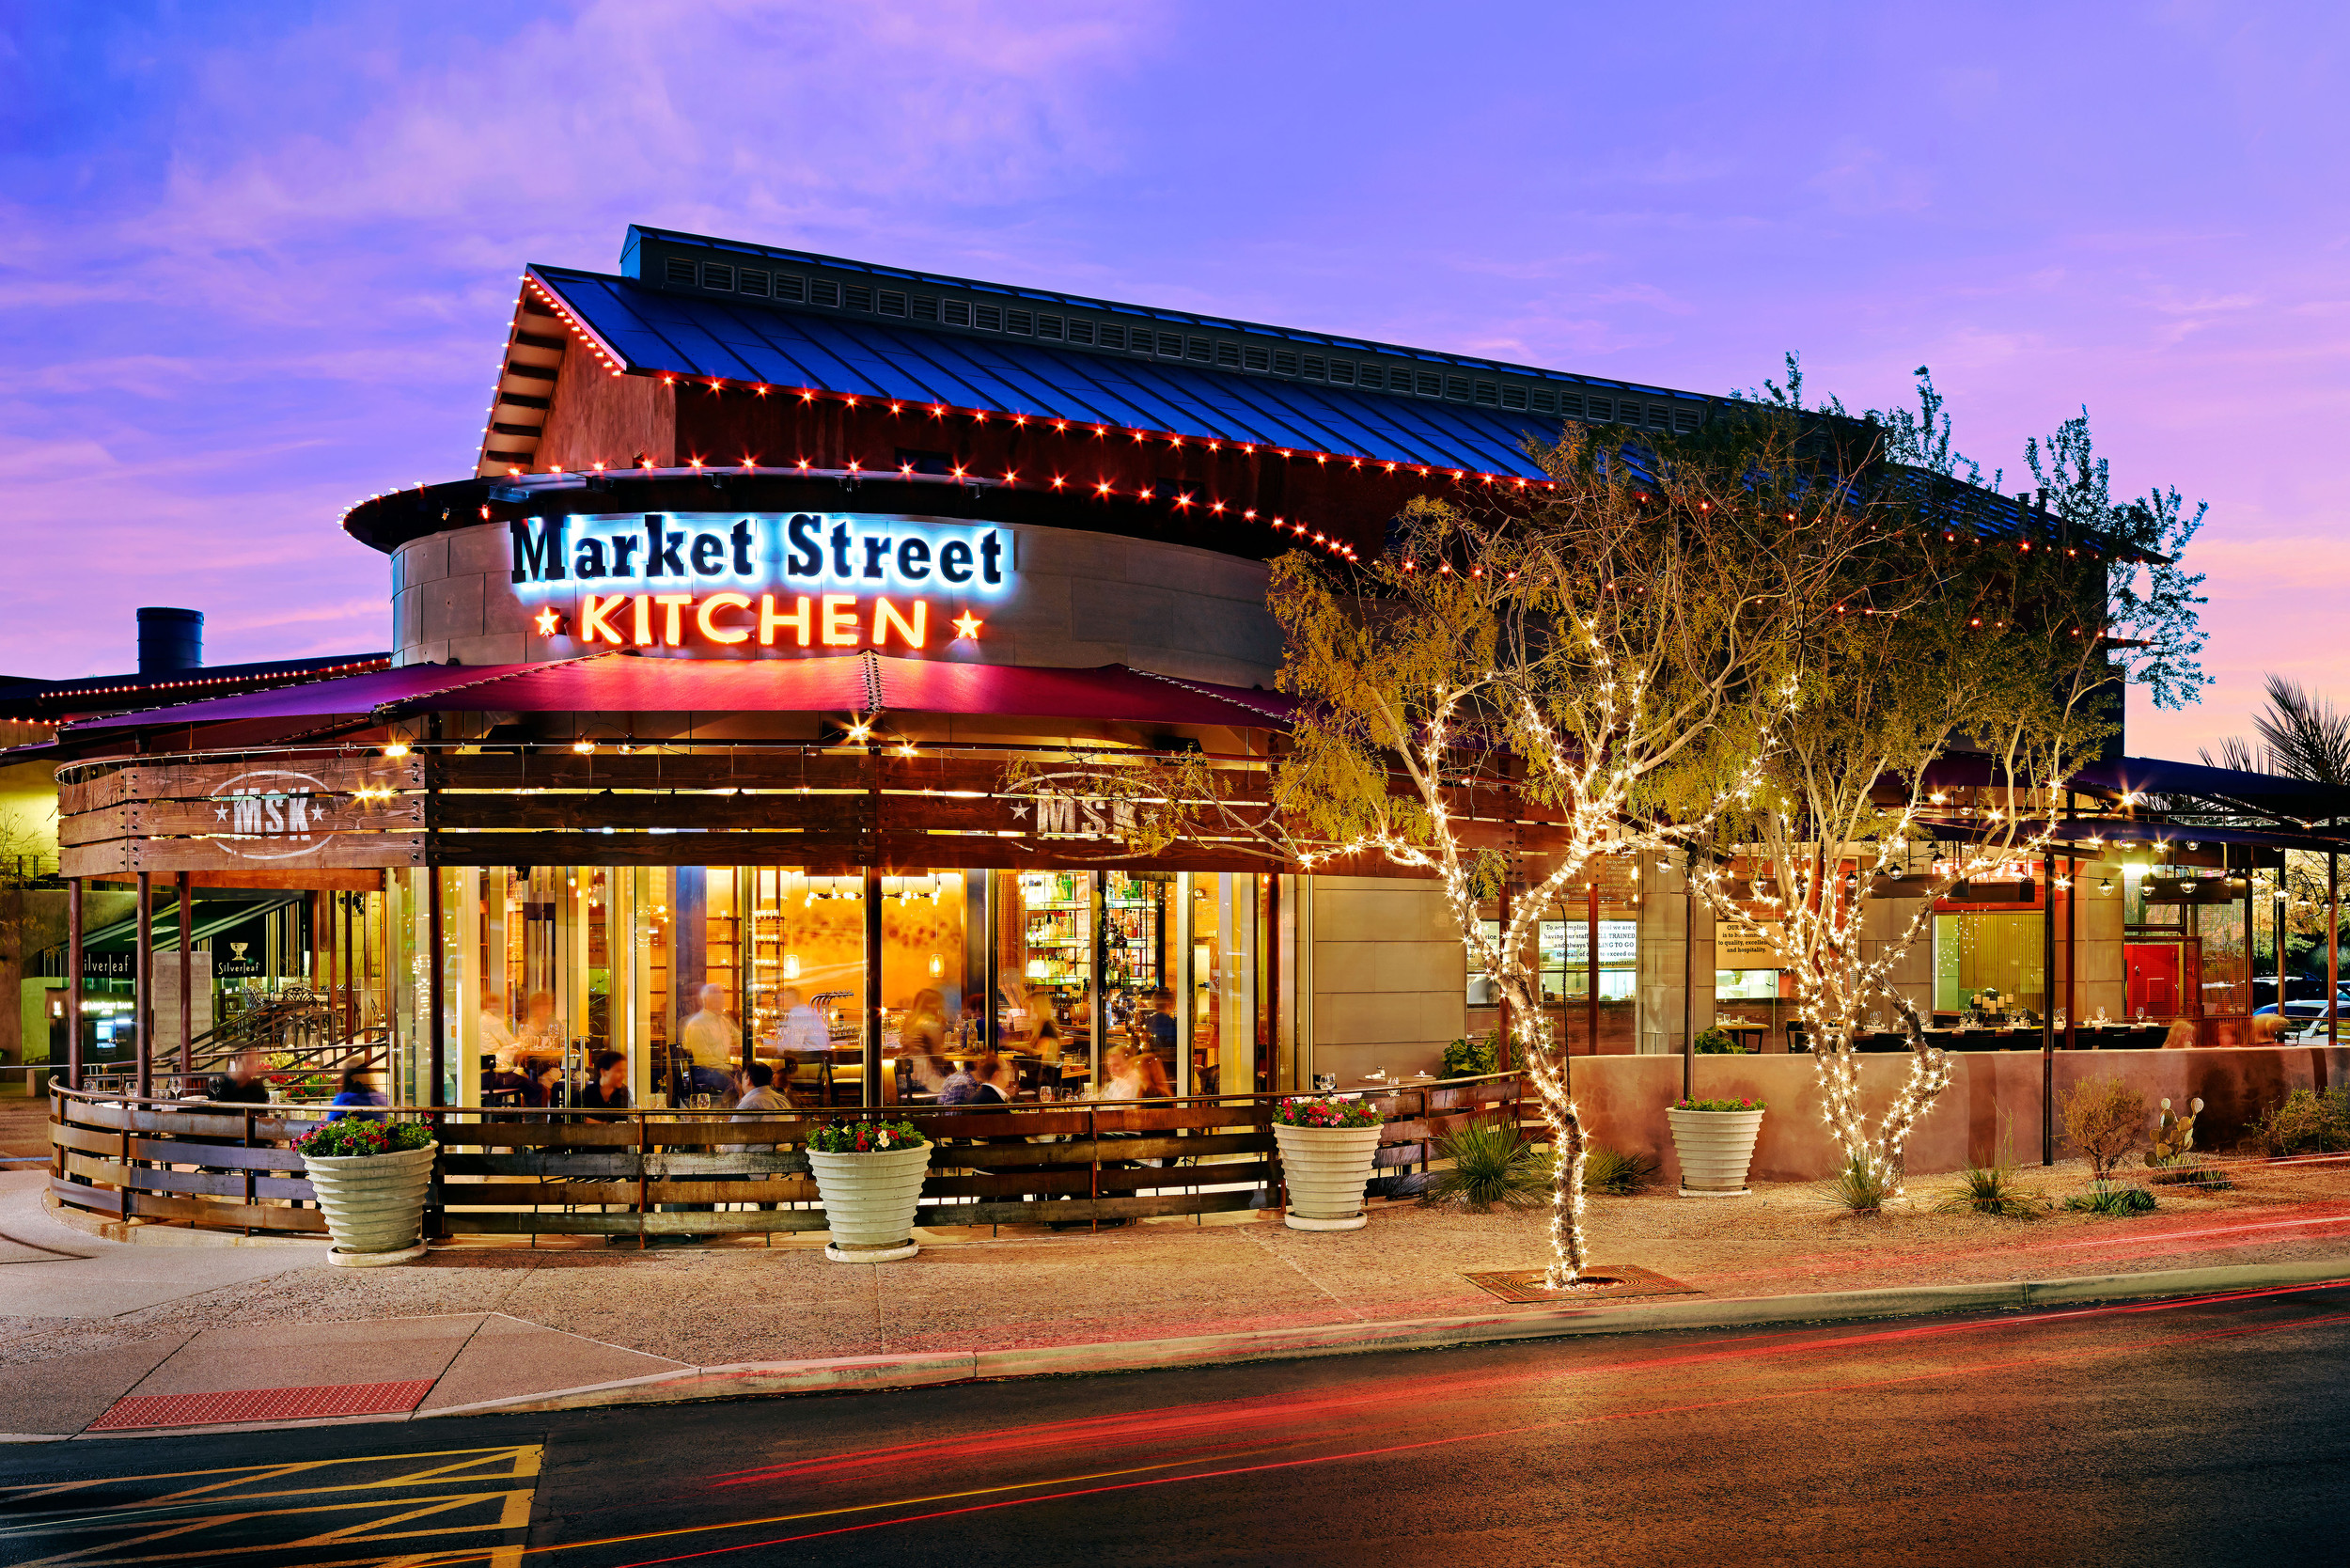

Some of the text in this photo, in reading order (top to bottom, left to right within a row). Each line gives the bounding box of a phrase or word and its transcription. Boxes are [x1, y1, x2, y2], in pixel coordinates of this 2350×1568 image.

[510, 513, 1002, 584] Market Street
[581, 592, 926, 648] KITCHEN
[233, 787, 311, 840] MSK
[1037, 788, 1141, 844] MSK
[84, 953, 130, 976] ilverleaf
[218, 962, 260, 975] Silverleaf
